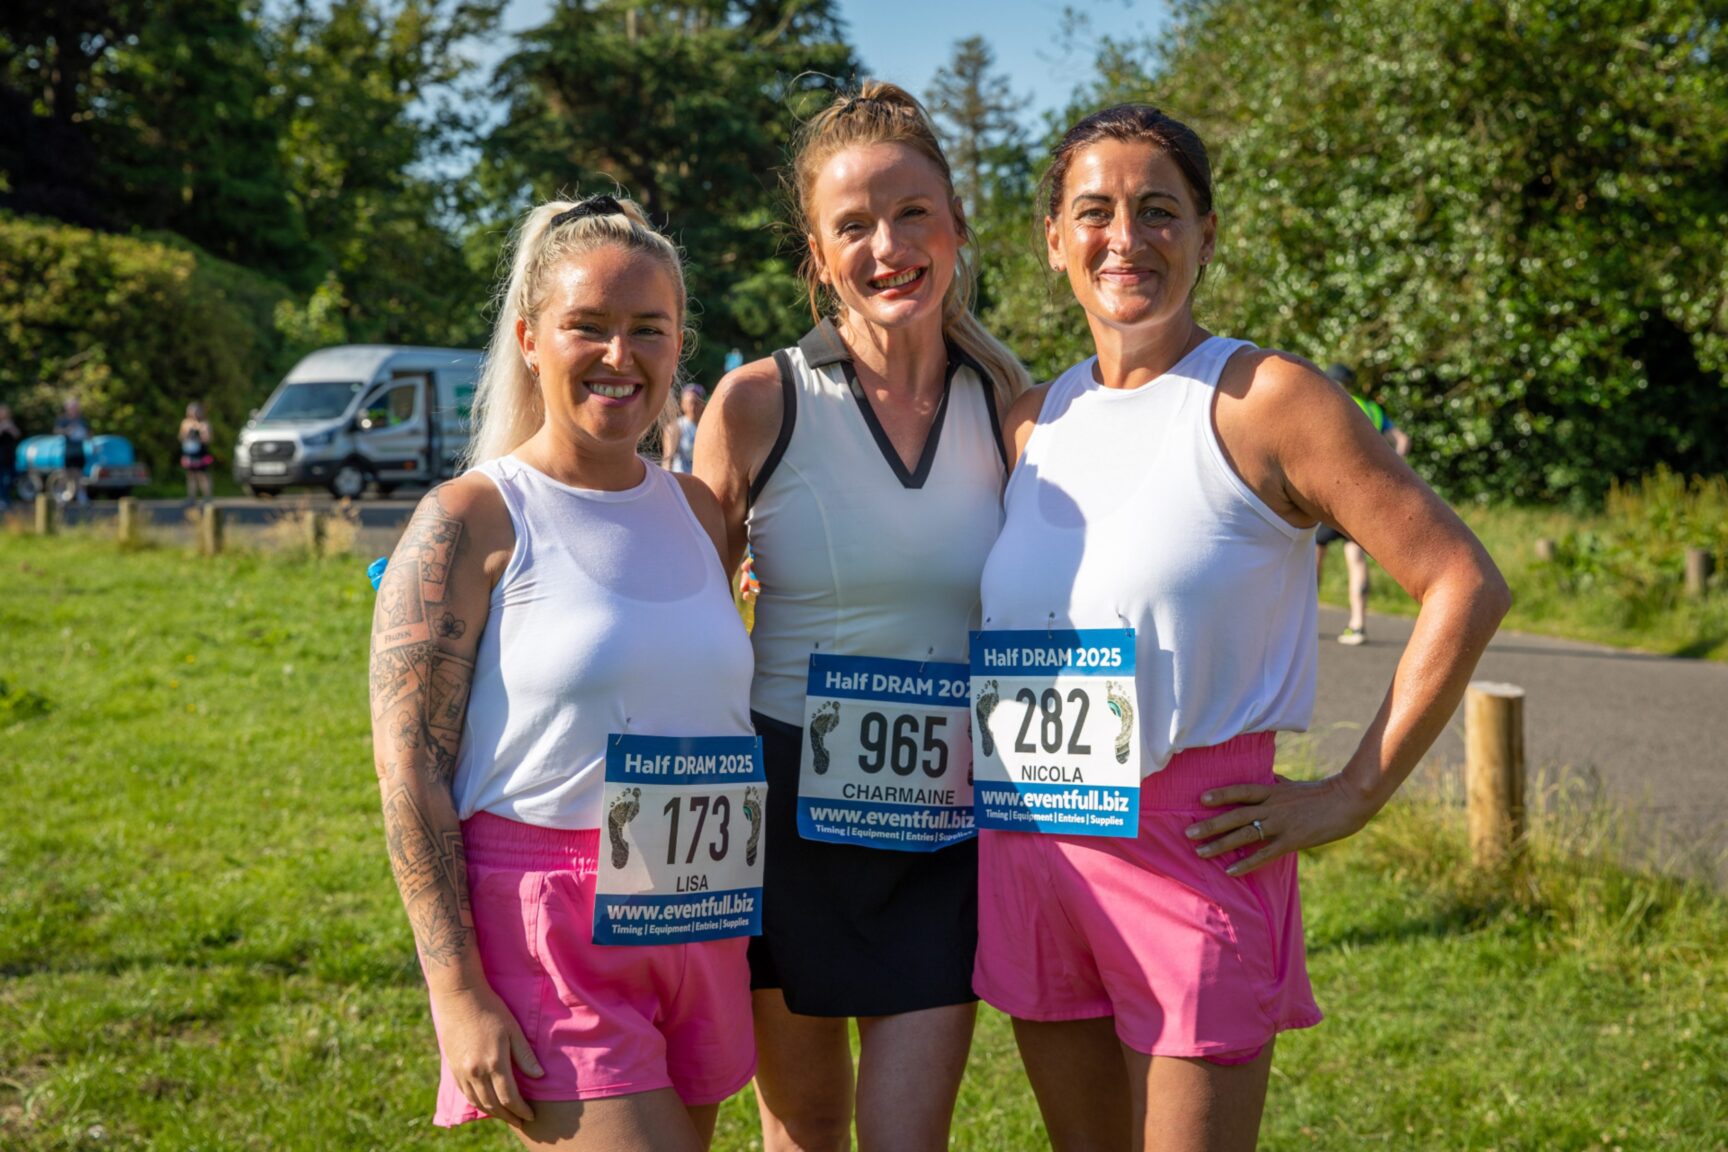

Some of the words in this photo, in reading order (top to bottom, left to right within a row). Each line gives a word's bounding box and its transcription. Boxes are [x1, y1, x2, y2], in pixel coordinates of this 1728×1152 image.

[984, 648, 1019, 667] Half
[1021, 649, 1072, 667] DRAM
[1075, 647, 1122, 667] 2025
[825, 671, 869, 690] Half
[872, 675, 933, 697] DRAM
[1014, 687, 1091, 755] 282
[858, 712, 949, 778] 965
[624, 753, 671, 775] Half
[673, 755, 716, 774] DRAM
[719, 754, 754, 774] 2025
[1021, 765, 1084, 783] NICOLA
[842, 783, 956, 805] CHARMAINE
[981, 789, 1129, 812] www.eventfull.biz
[809, 806, 976, 829] www.eventfull.biz
[986, 809, 1008, 821] Timing
[1012, 811, 1053, 823] Equipment
[1058, 814, 1085, 823] Entries
[1090, 815, 1124, 827] Supplies
[663, 795, 731, 865] 173
[815, 824, 845, 836] Timing
[851, 828, 900, 841] Equipment
[906, 832, 934, 842] Entries
[676, 874, 709, 892] LISA
[607, 893, 754, 920] www.eventfull.biz
[612, 923, 643, 936] Timing
[649, 923, 691, 935] Equipment
[695, 919, 719, 931] Entries
[722, 917, 749, 928] Supplies
